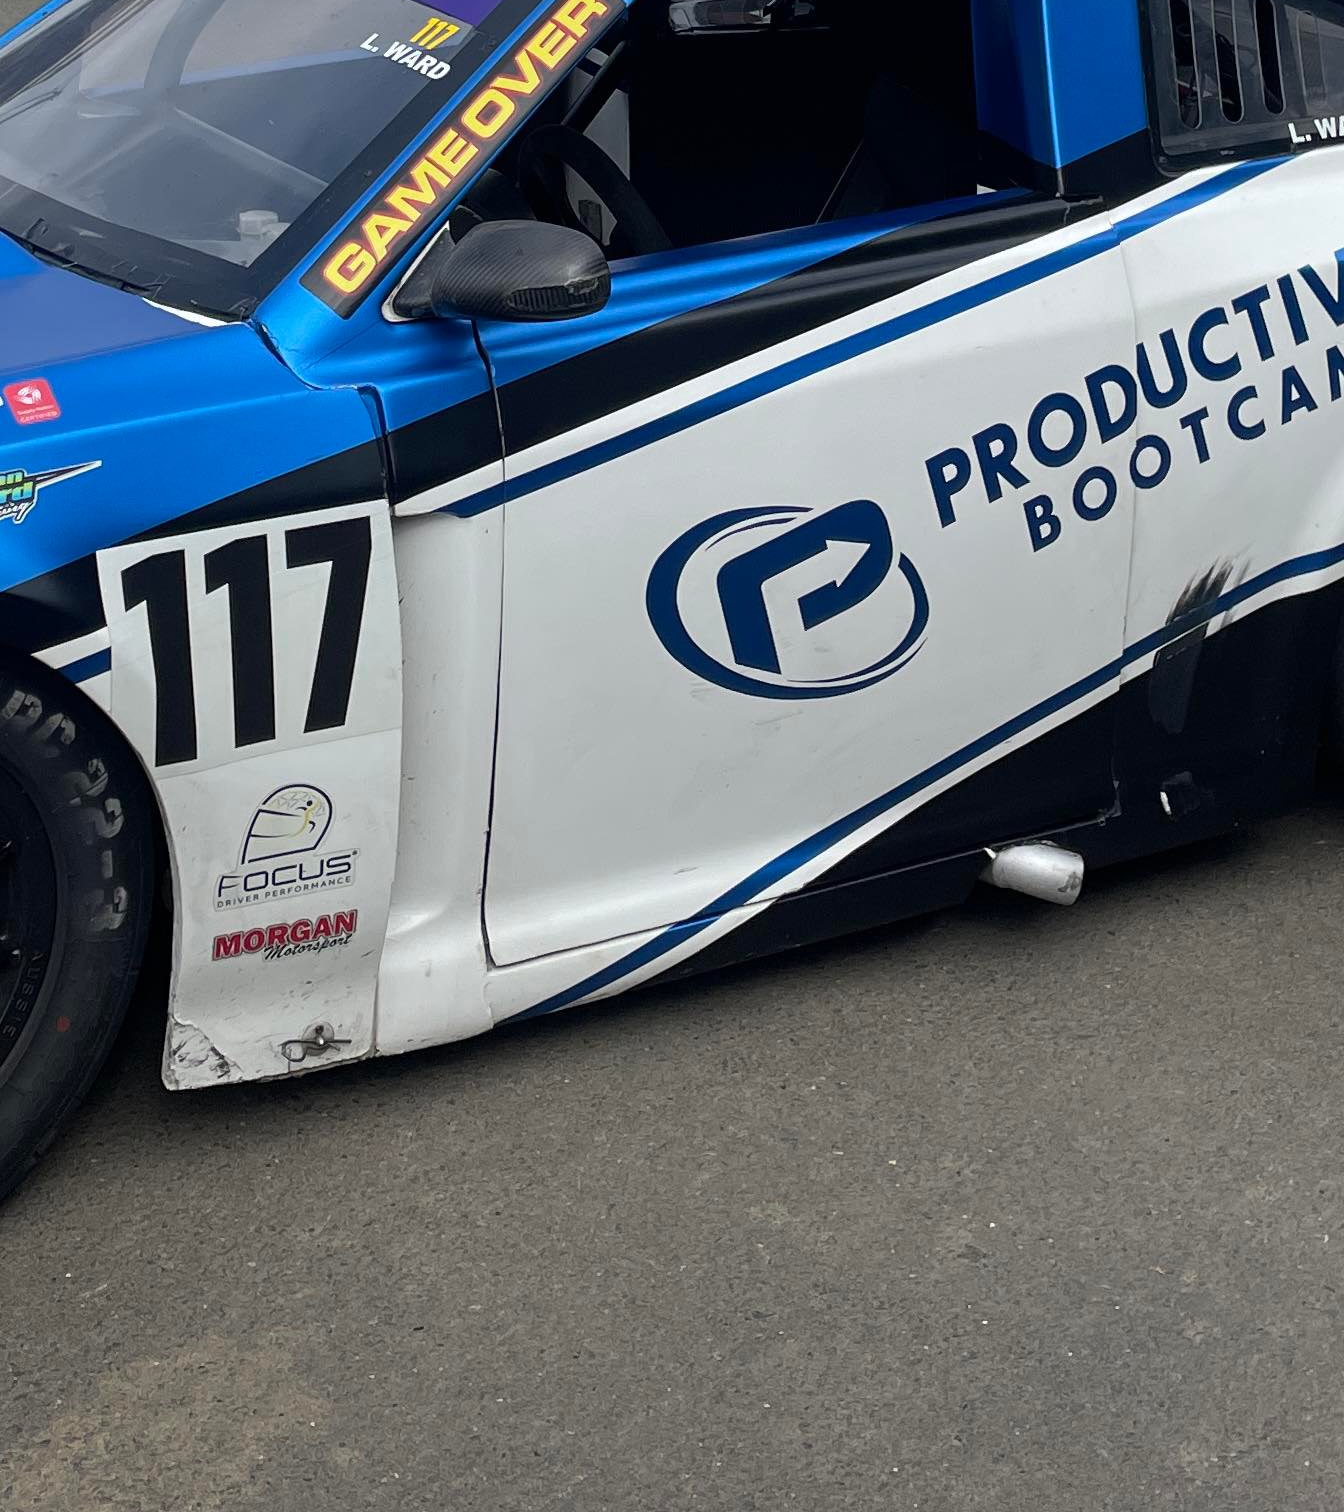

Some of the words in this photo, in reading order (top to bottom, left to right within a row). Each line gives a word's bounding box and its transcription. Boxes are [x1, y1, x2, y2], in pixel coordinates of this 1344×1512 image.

[409, 17, 461, 50] 117
[359, 32, 379, 53] L.
[383, 40, 452, 80] WARD
[1287, 122, 1312, 144] L.
[121, 515, 373, 768] 117
[216, 894, 259, 909] DRIVER
[264, 875, 352, 899] PERFORMANCE
[217, 854, 352, 898] FOCUS
[212, 908, 358, 962] MORGAN
[263, 933, 354, 961] Motorsport
